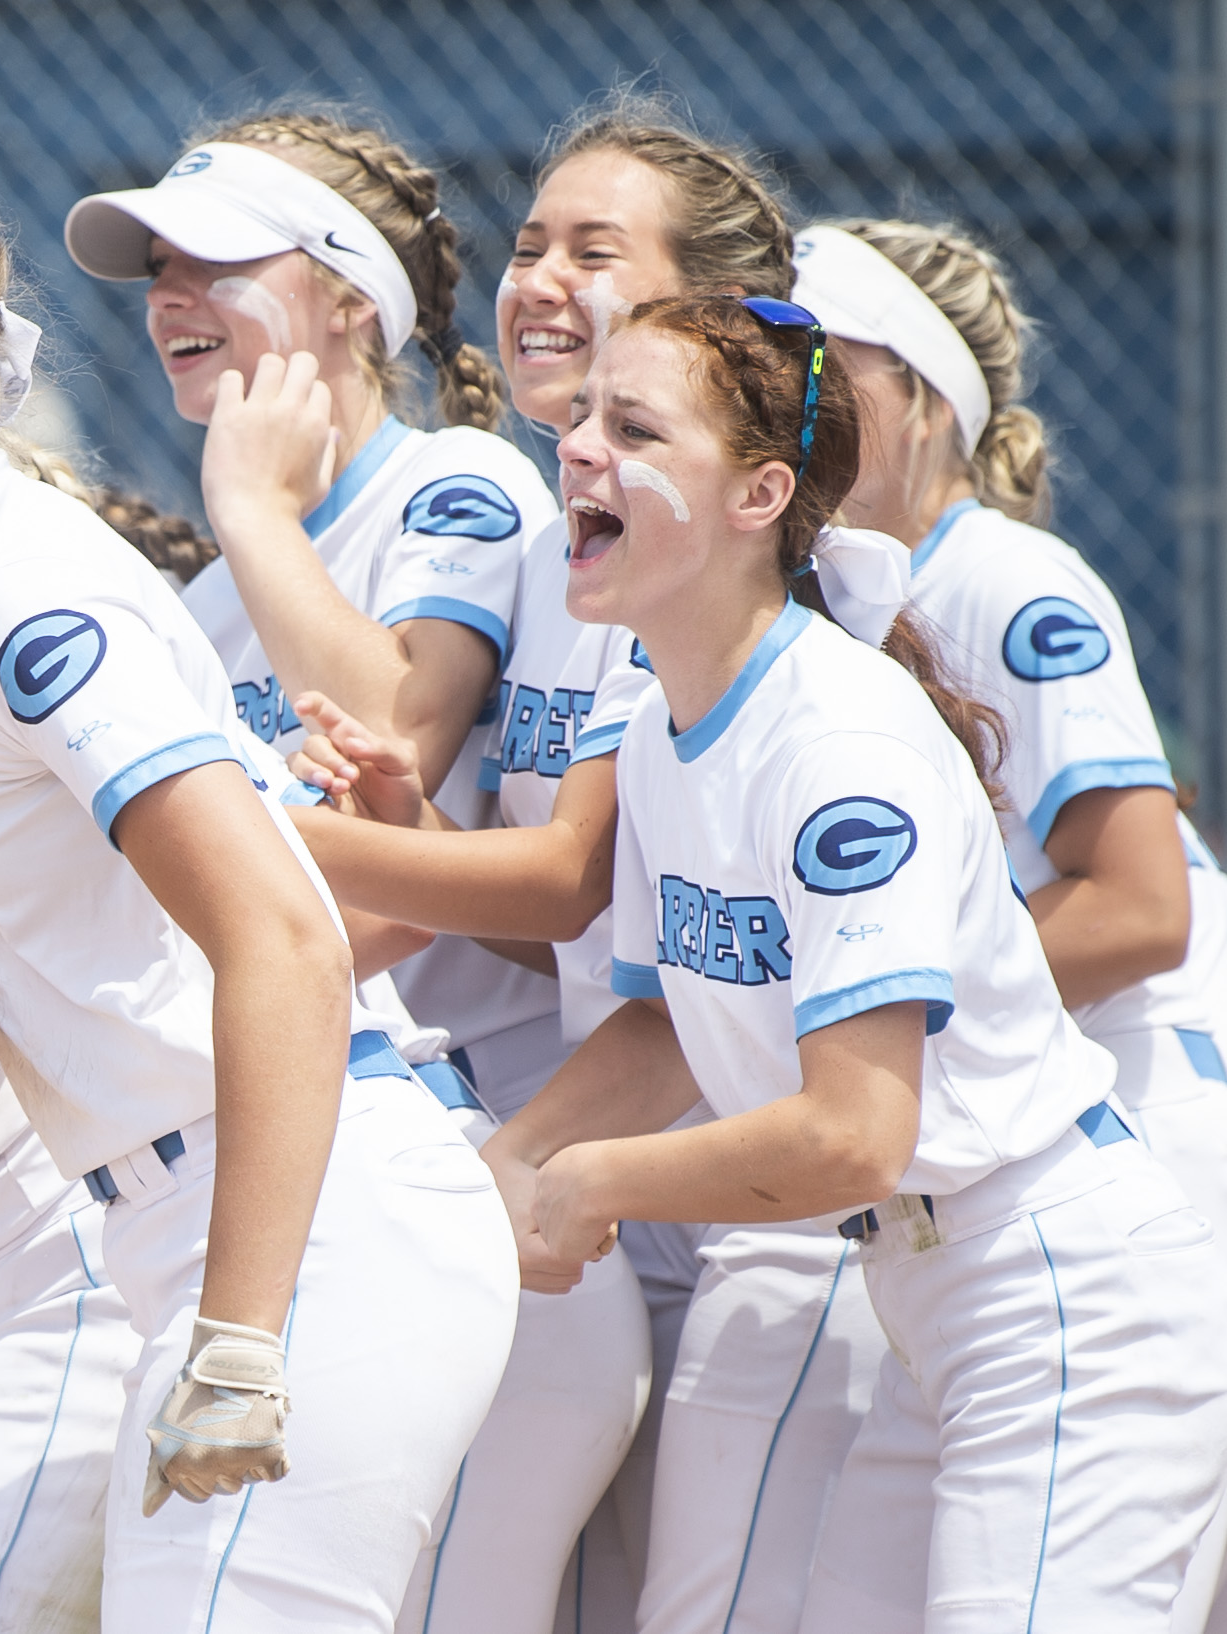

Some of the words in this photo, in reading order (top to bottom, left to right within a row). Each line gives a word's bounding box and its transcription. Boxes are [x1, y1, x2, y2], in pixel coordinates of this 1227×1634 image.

[1003, 596, 1111, 683] G
[791, 796, 918, 896] G
[656, 873, 794, 987] RBER
[205, 1358, 268, 1375] EASTON
